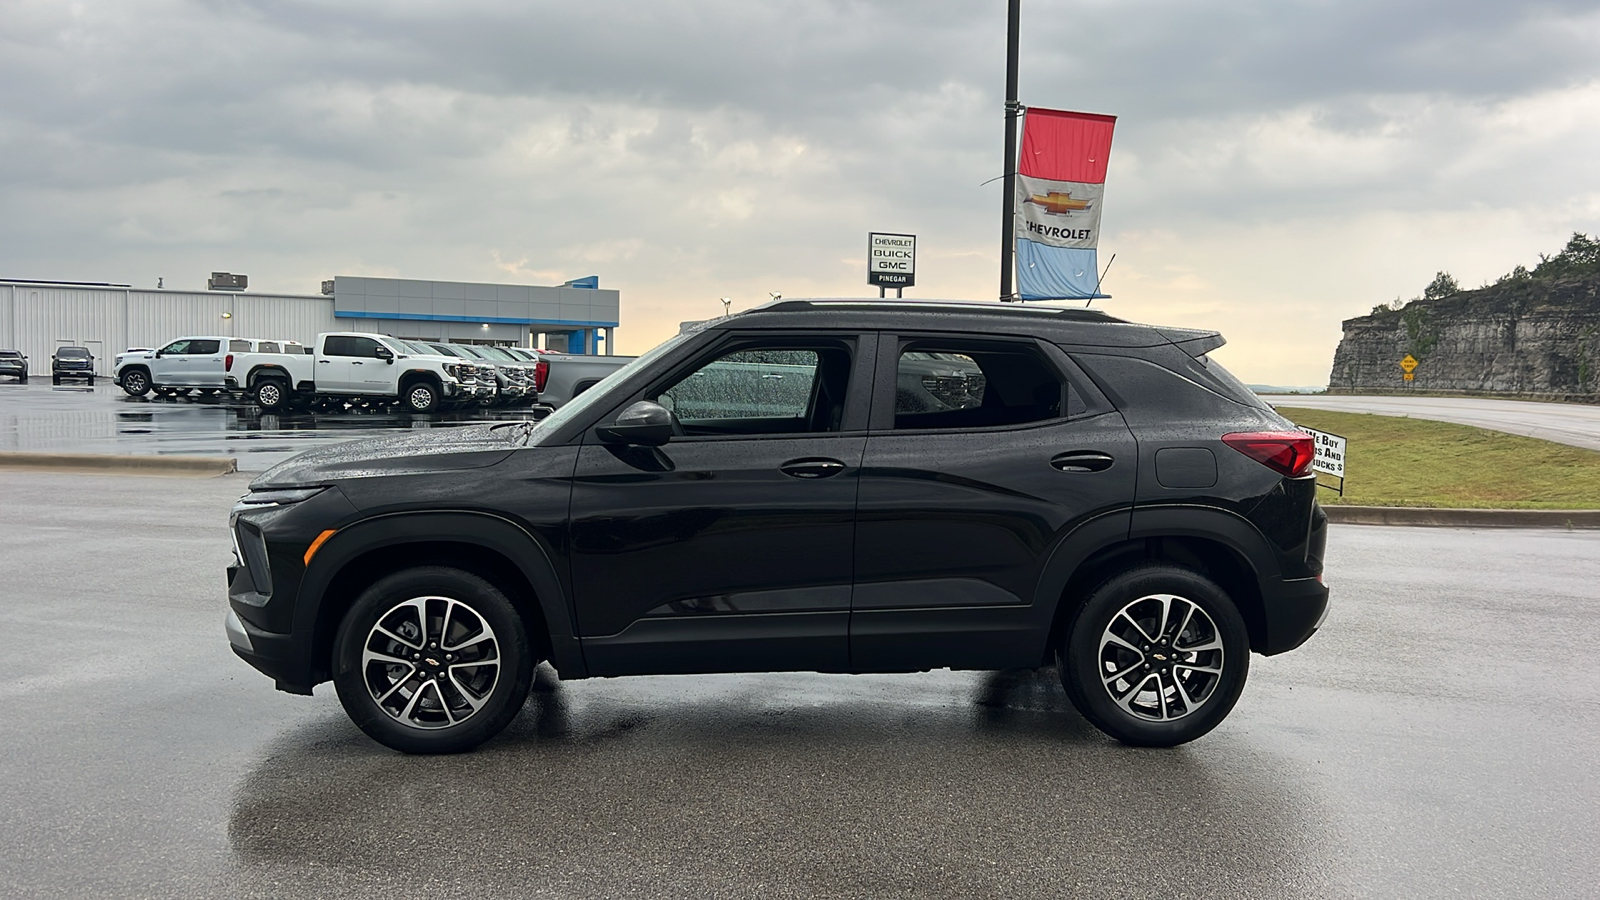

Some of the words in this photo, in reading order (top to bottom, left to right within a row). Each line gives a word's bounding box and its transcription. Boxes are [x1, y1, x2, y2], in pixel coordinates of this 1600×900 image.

[875, 238, 912, 247] CHEVROLET
[874, 249, 912, 259] BUICK
[879, 261, 907, 270] GMC
[1322, 435, 1339, 448] BUY
[1324, 447, 1341, 461] AND
[1313, 459, 1335, 471] UCKS
